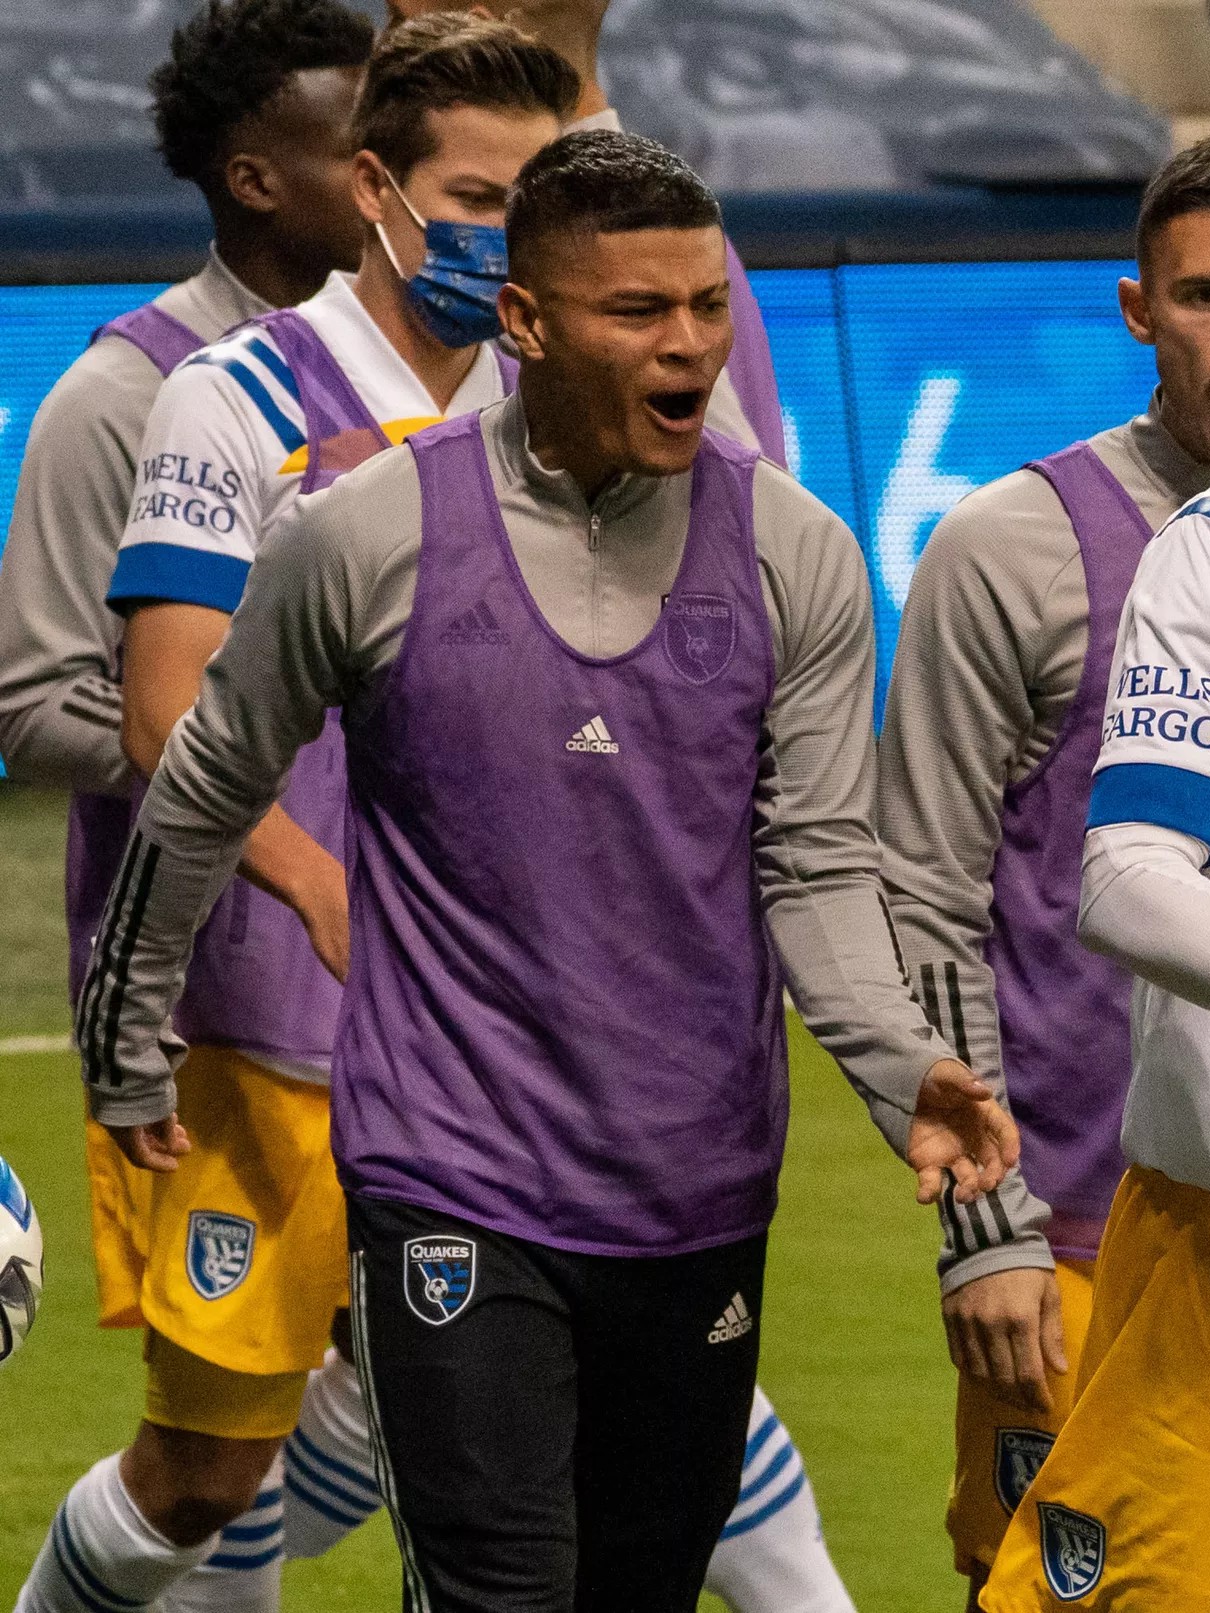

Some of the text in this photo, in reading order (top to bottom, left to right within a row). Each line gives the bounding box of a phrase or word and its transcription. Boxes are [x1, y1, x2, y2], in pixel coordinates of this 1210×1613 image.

[143, 453, 241, 498] WELLS
[132, 491, 236, 534] FARGO
[565, 740, 619, 754] adidas
[410, 1244, 470, 1258] QUAKES
